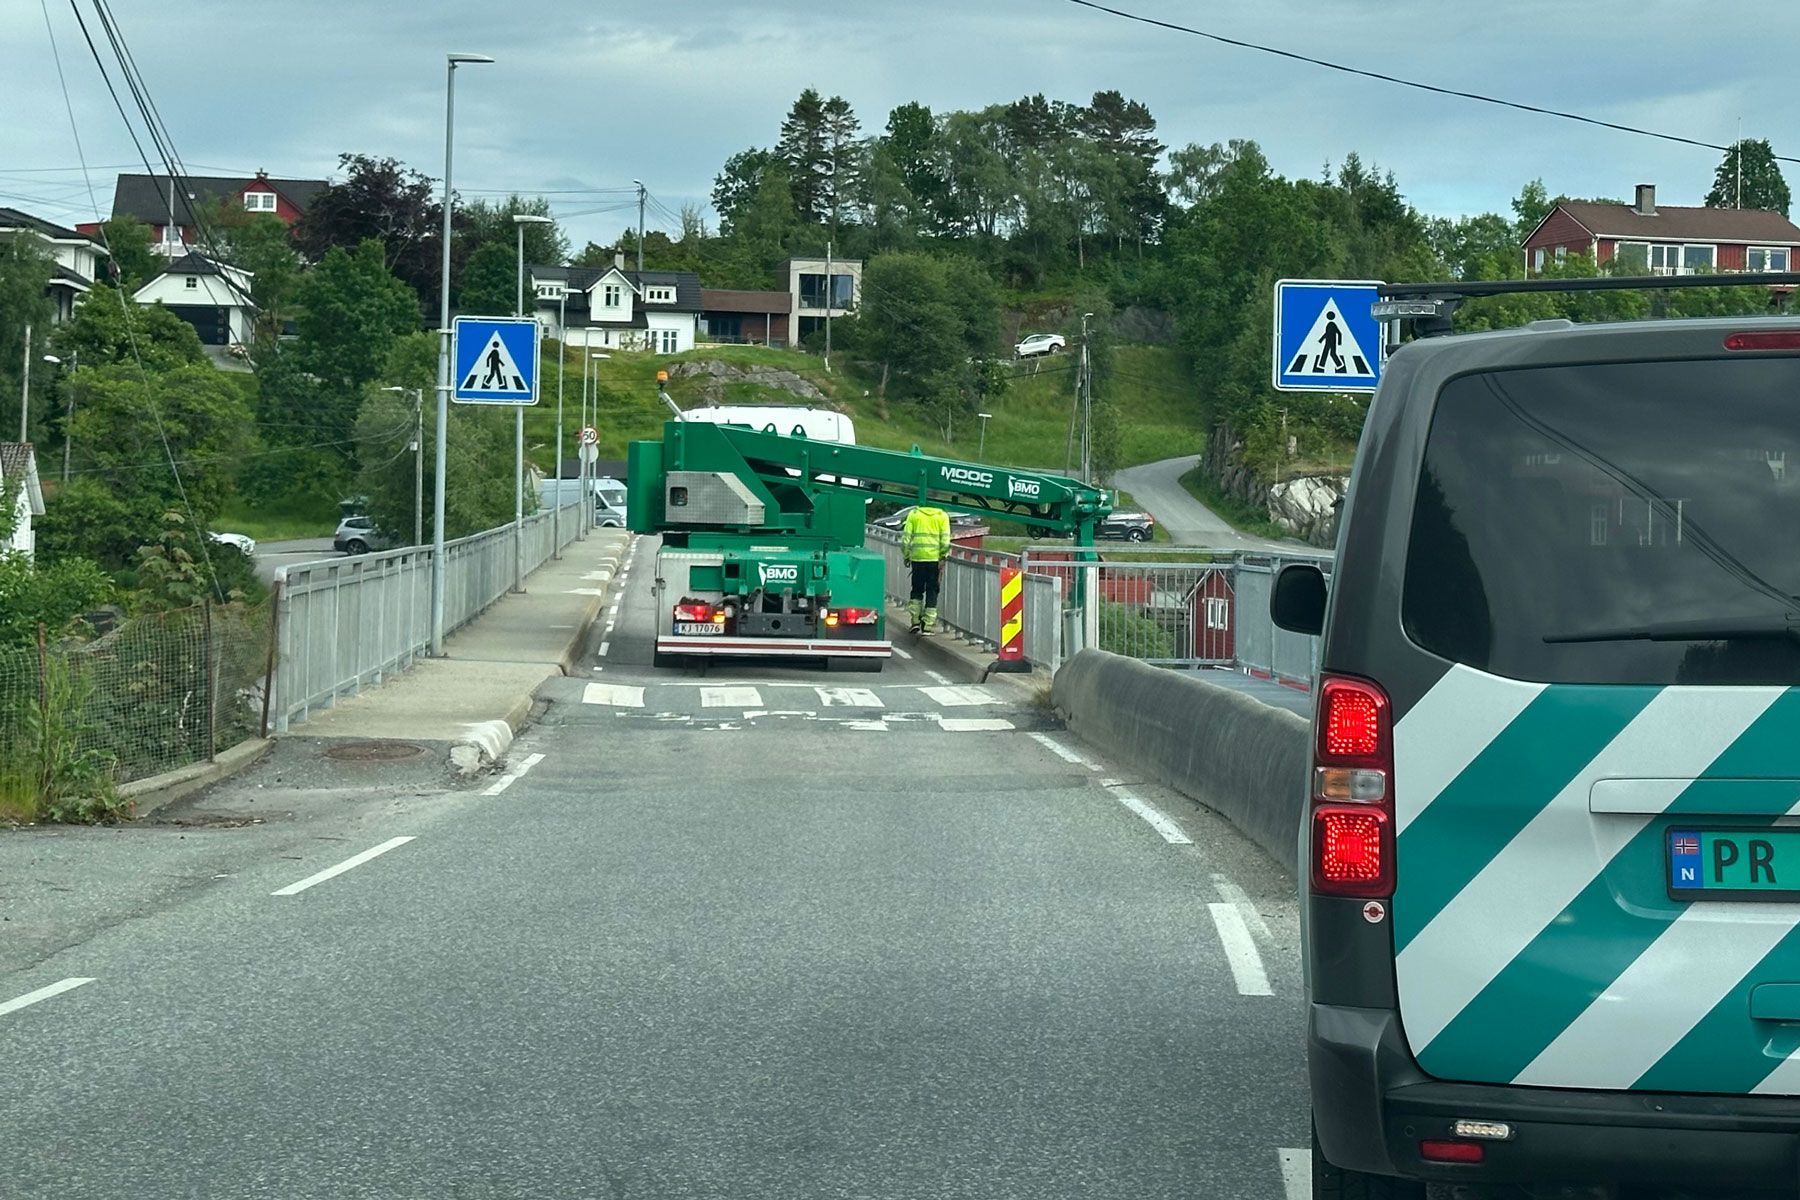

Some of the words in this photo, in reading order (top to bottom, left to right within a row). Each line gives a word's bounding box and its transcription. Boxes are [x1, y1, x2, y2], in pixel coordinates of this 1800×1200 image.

[583, 430, 596, 441] 50
[1014, 481, 1040, 495] BMO
[766, 568, 798, 580] BMO
[681, 624, 692, 633] KJ
[695, 624, 721, 633] 17076
[1712, 838, 1777, 884] PR
[1681, 867, 1695, 881] N
